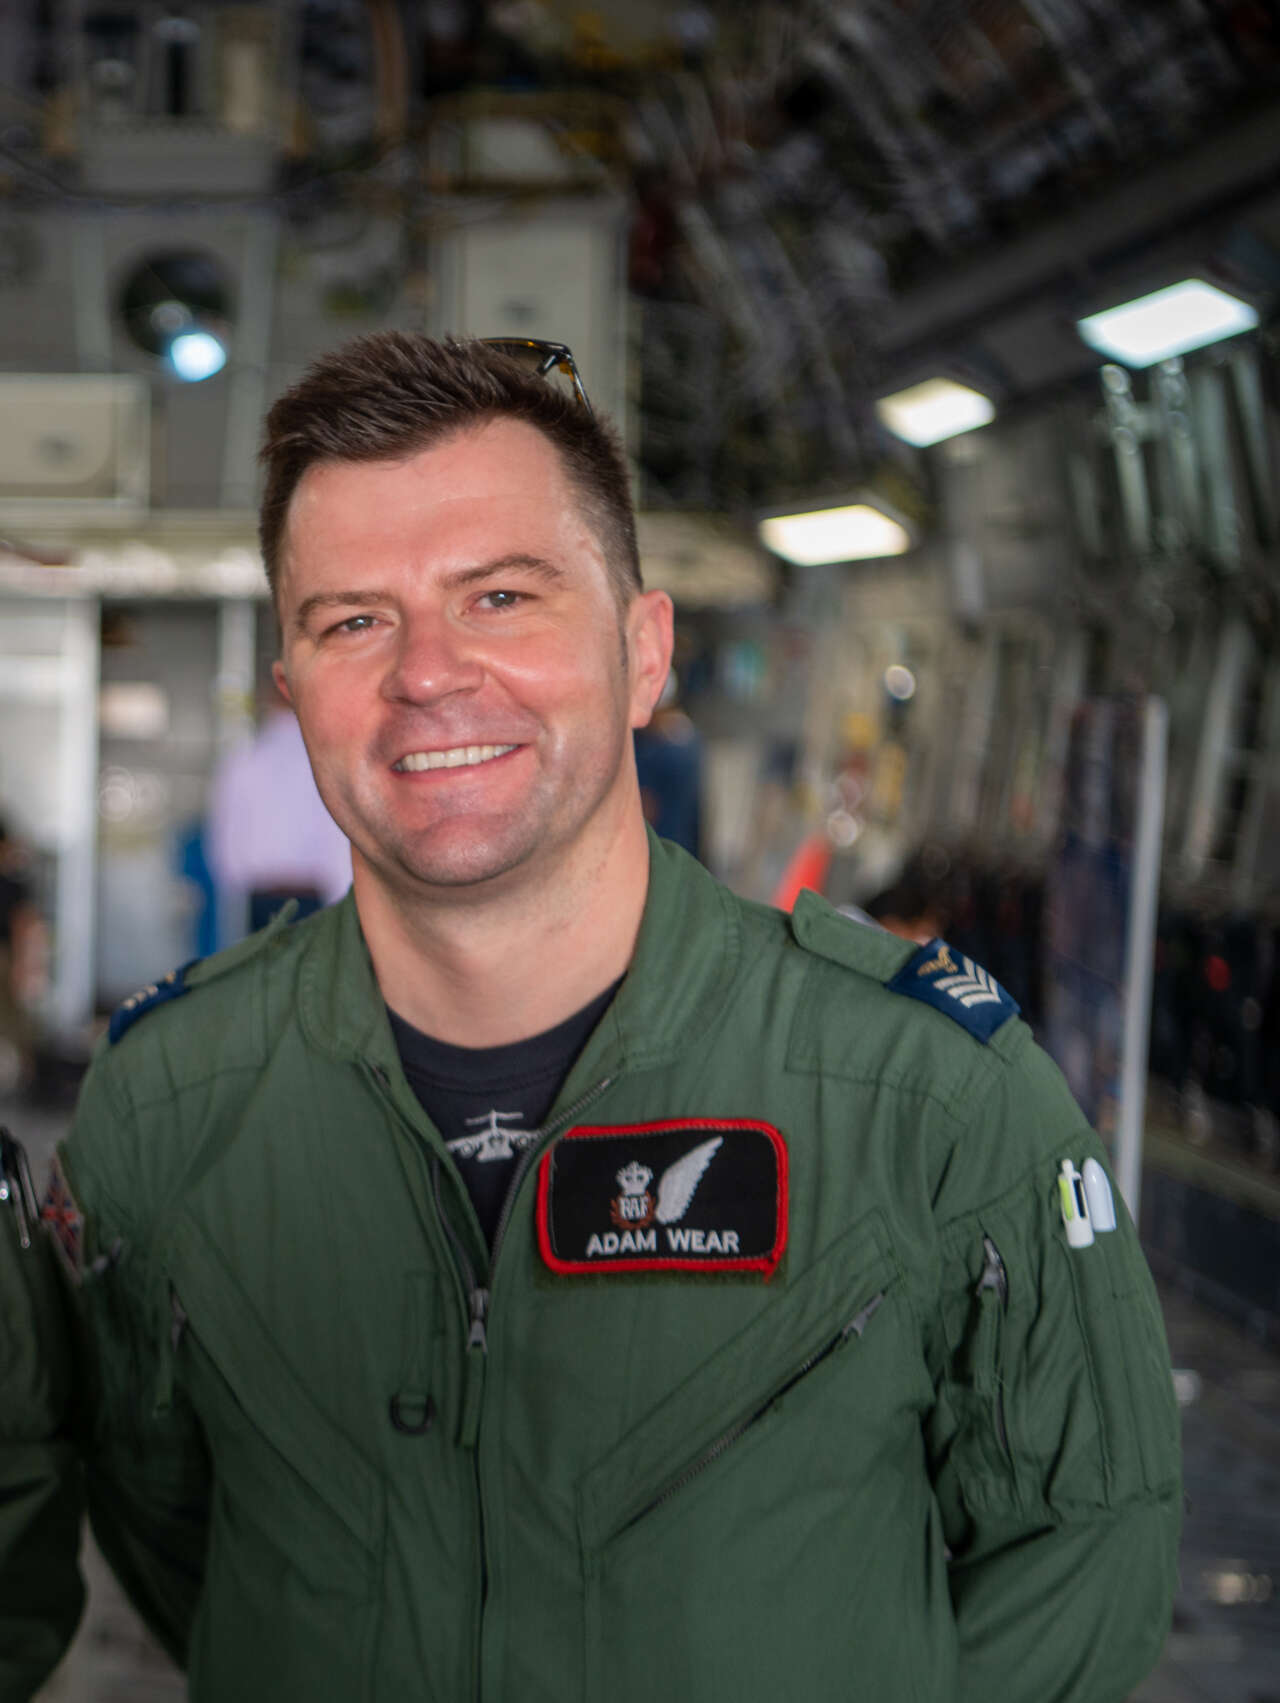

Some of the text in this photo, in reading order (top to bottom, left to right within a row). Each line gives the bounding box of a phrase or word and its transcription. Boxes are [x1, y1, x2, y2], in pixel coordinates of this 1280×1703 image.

[619, 1196, 649, 1219] RAF
[586, 1228, 740, 1257] ADAM WEAR
